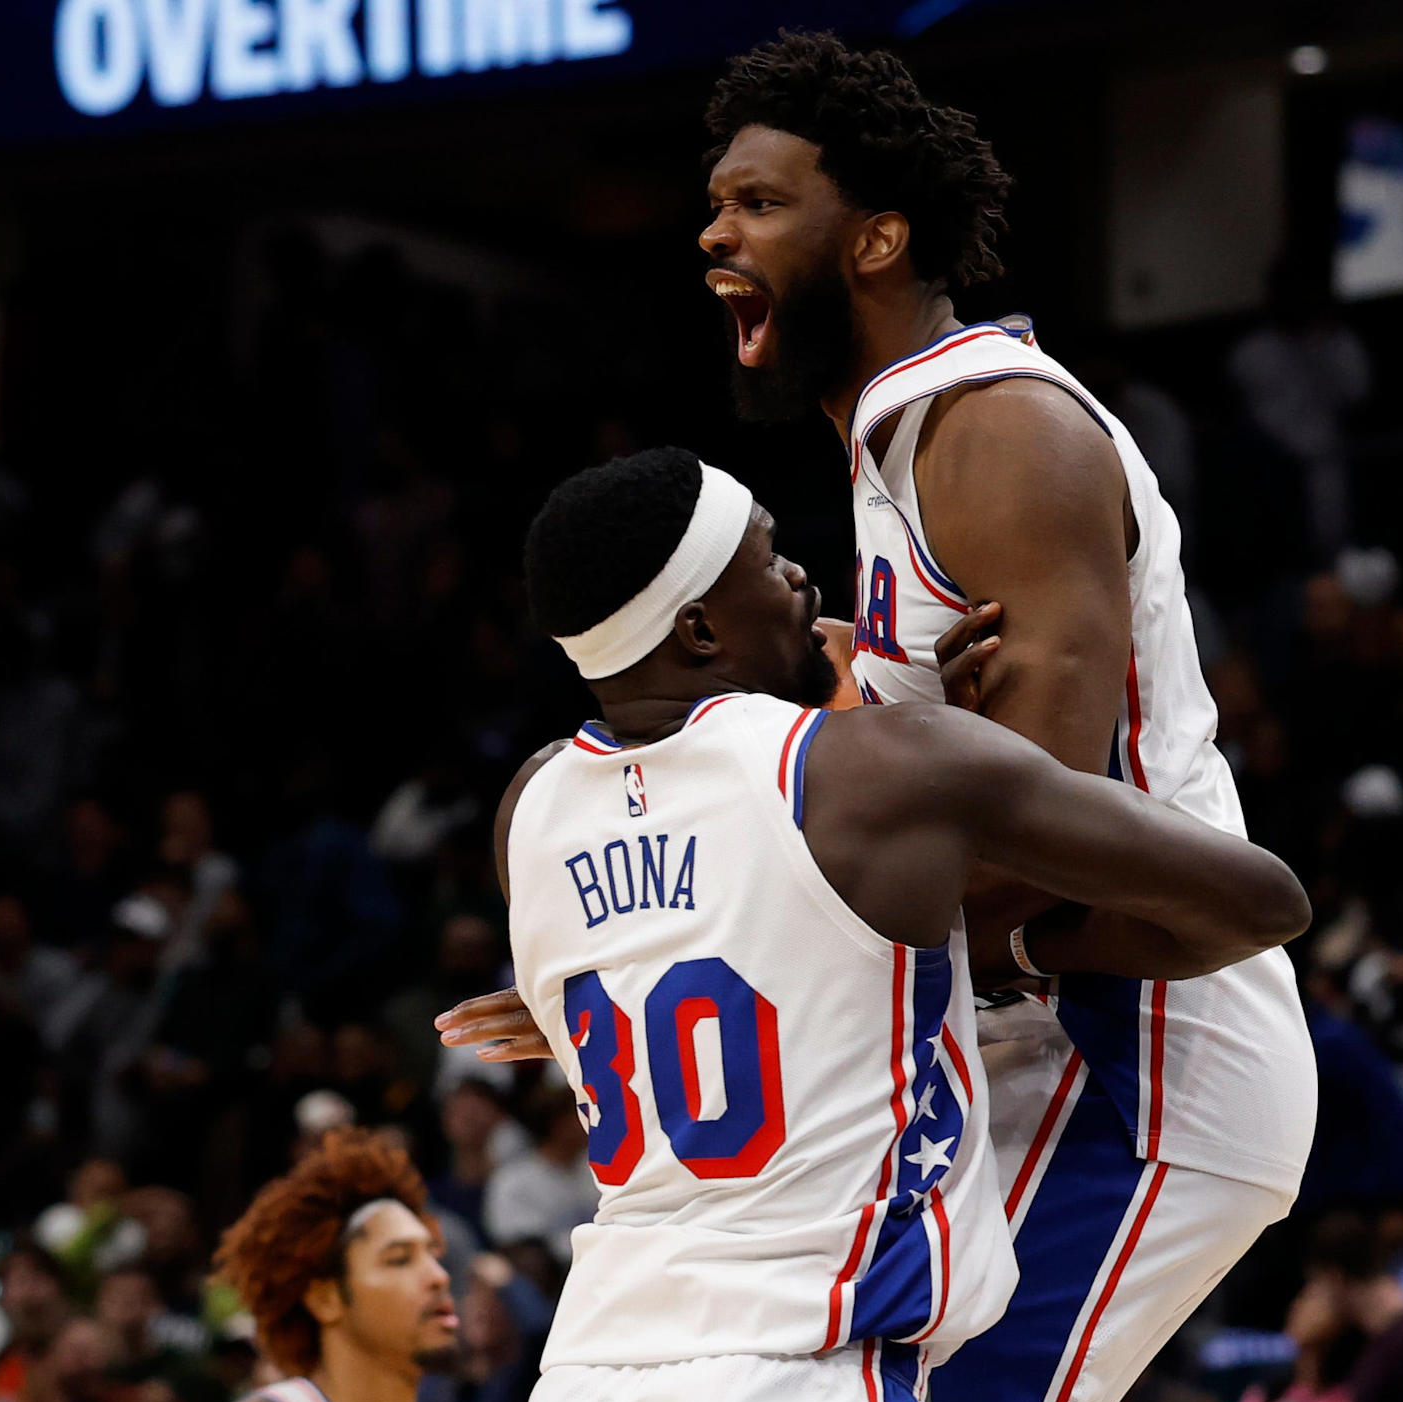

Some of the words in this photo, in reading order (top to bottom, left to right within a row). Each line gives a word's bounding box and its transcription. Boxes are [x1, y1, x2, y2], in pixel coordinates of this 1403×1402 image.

[54, 0, 631, 114] OVERTIME
[565, 833, 697, 929] BONA
[563, 956, 786, 1186] 30
